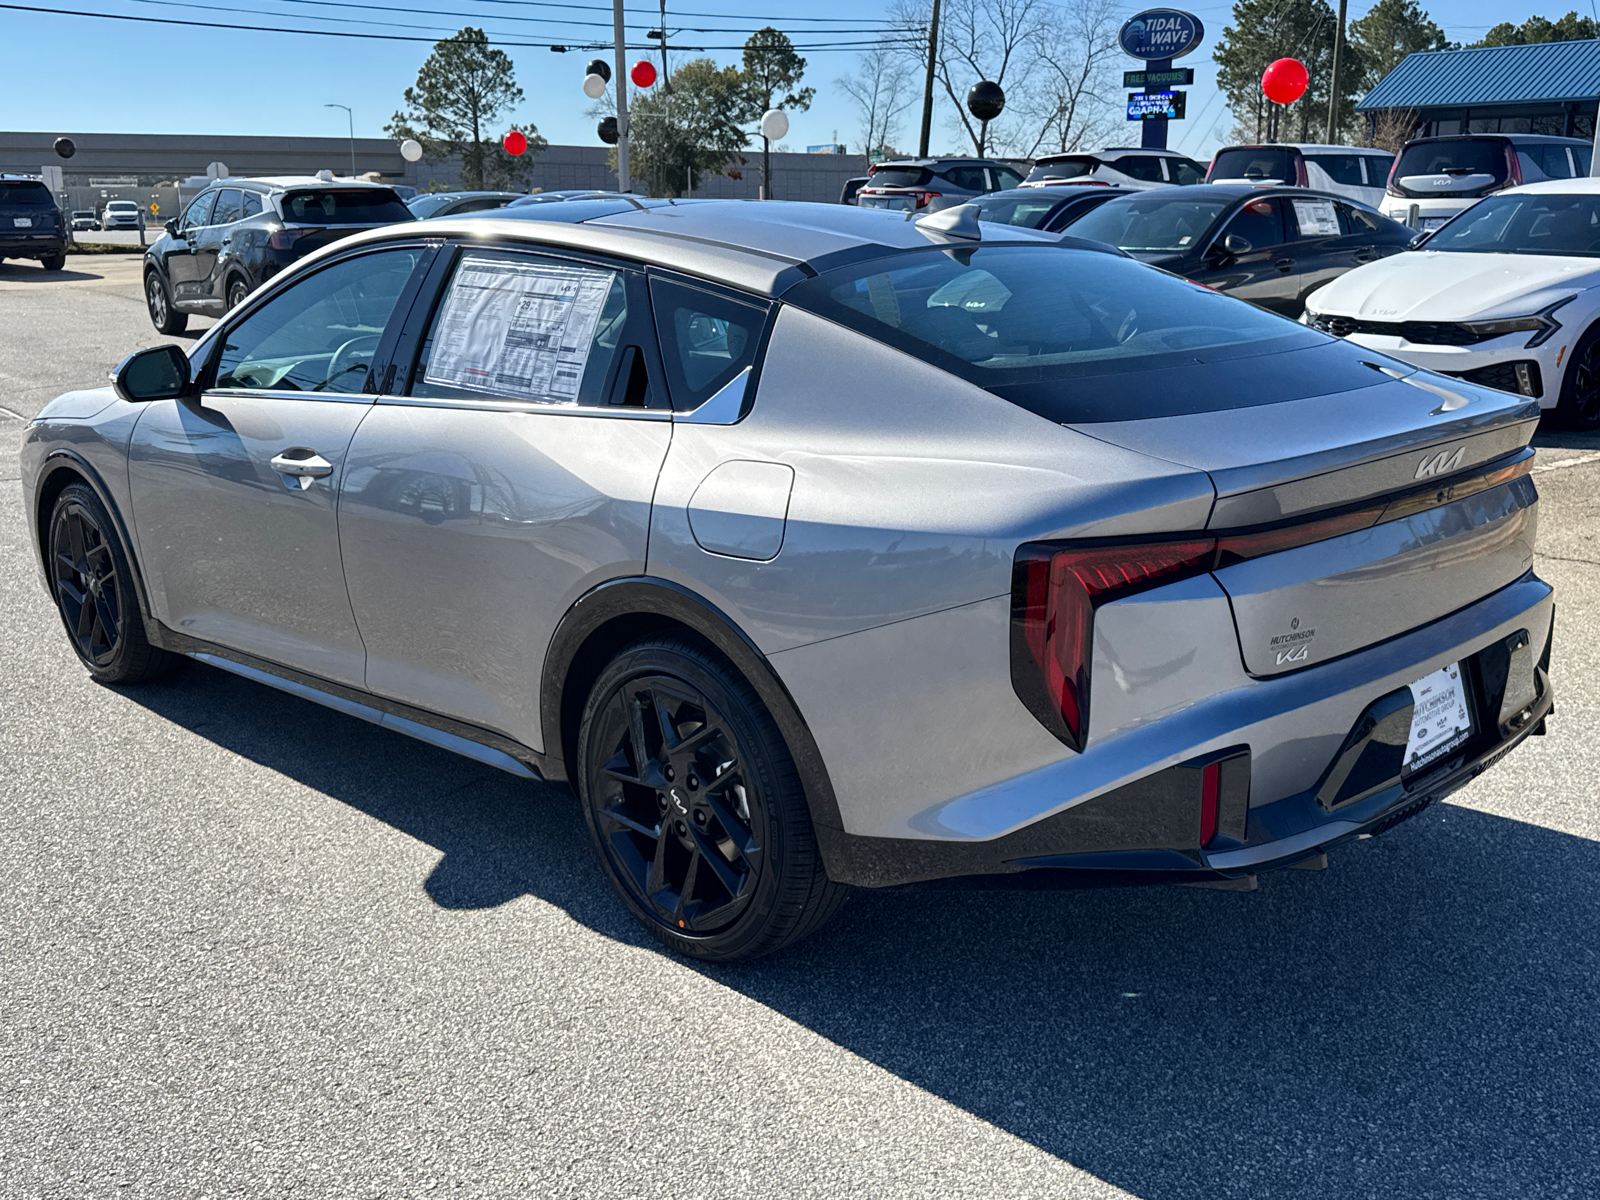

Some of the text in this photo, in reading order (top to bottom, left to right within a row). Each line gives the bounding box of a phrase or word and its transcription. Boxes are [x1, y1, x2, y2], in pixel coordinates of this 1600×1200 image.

[1146, 17, 1182, 32] TIDAL
[1150, 30, 1189, 45] WAVE
[1125, 71, 1183, 84] FREE VACUUMS
[1413, 446, 1466, 479] KIA
[1270, 628, 1316, 646] HUTCHINSON
[1275, 645, 1308, 666] K4
